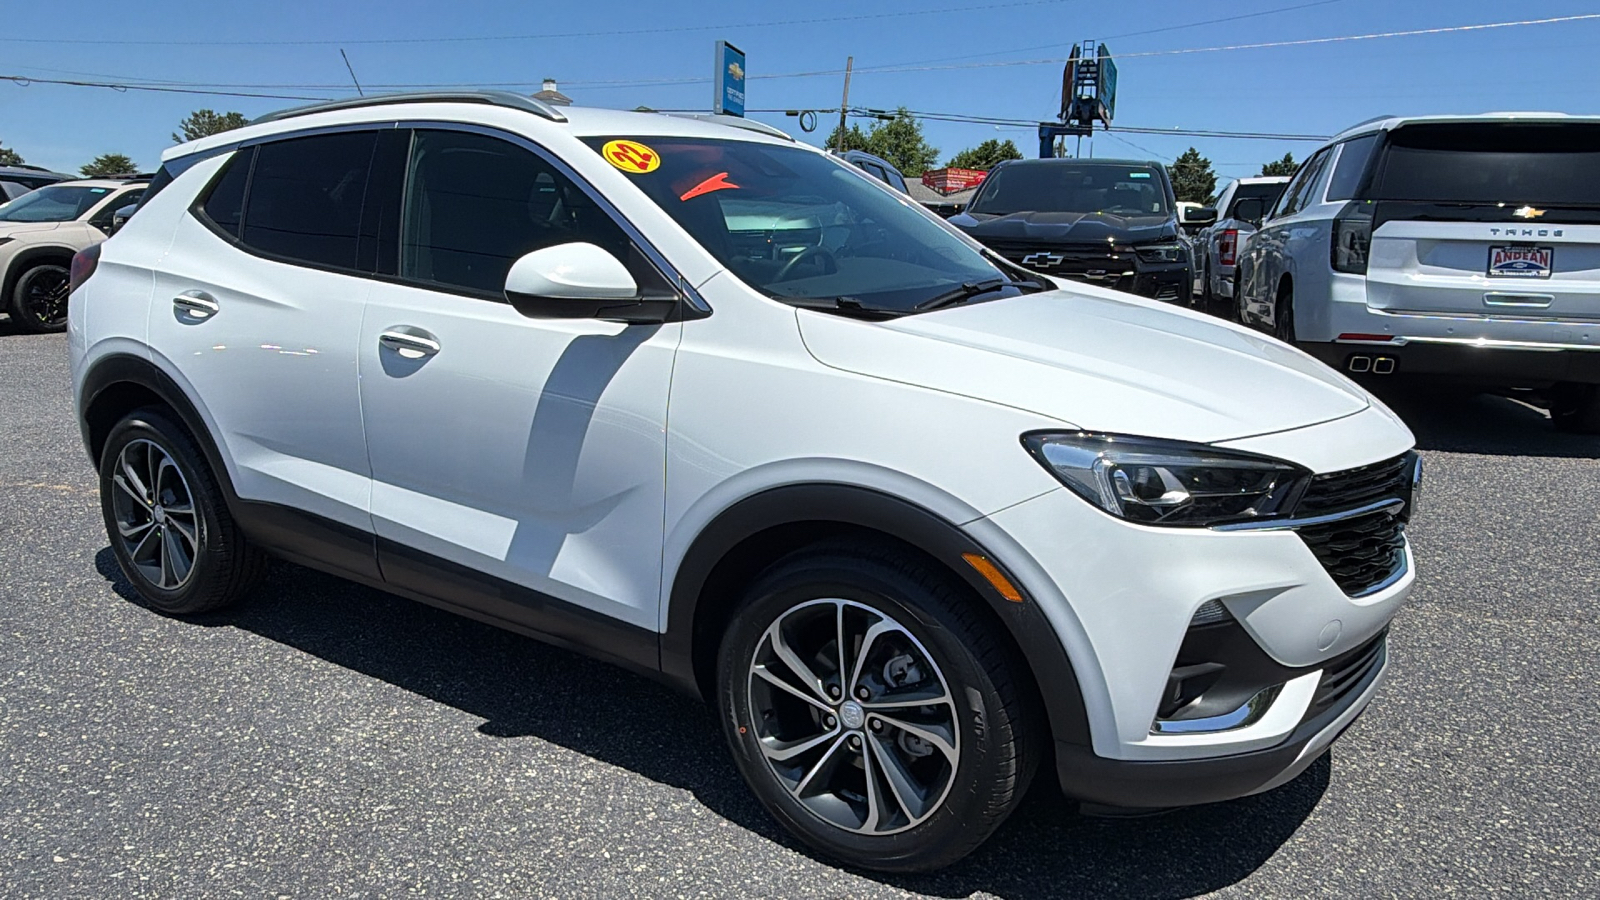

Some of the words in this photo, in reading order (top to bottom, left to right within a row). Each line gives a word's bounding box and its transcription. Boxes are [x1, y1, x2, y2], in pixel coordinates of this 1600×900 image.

[611, 143, 652, 171] 22
[1490, 228, 1563, 237] TAHOE
[1493, 251, 1549, 268] ANDEAN
